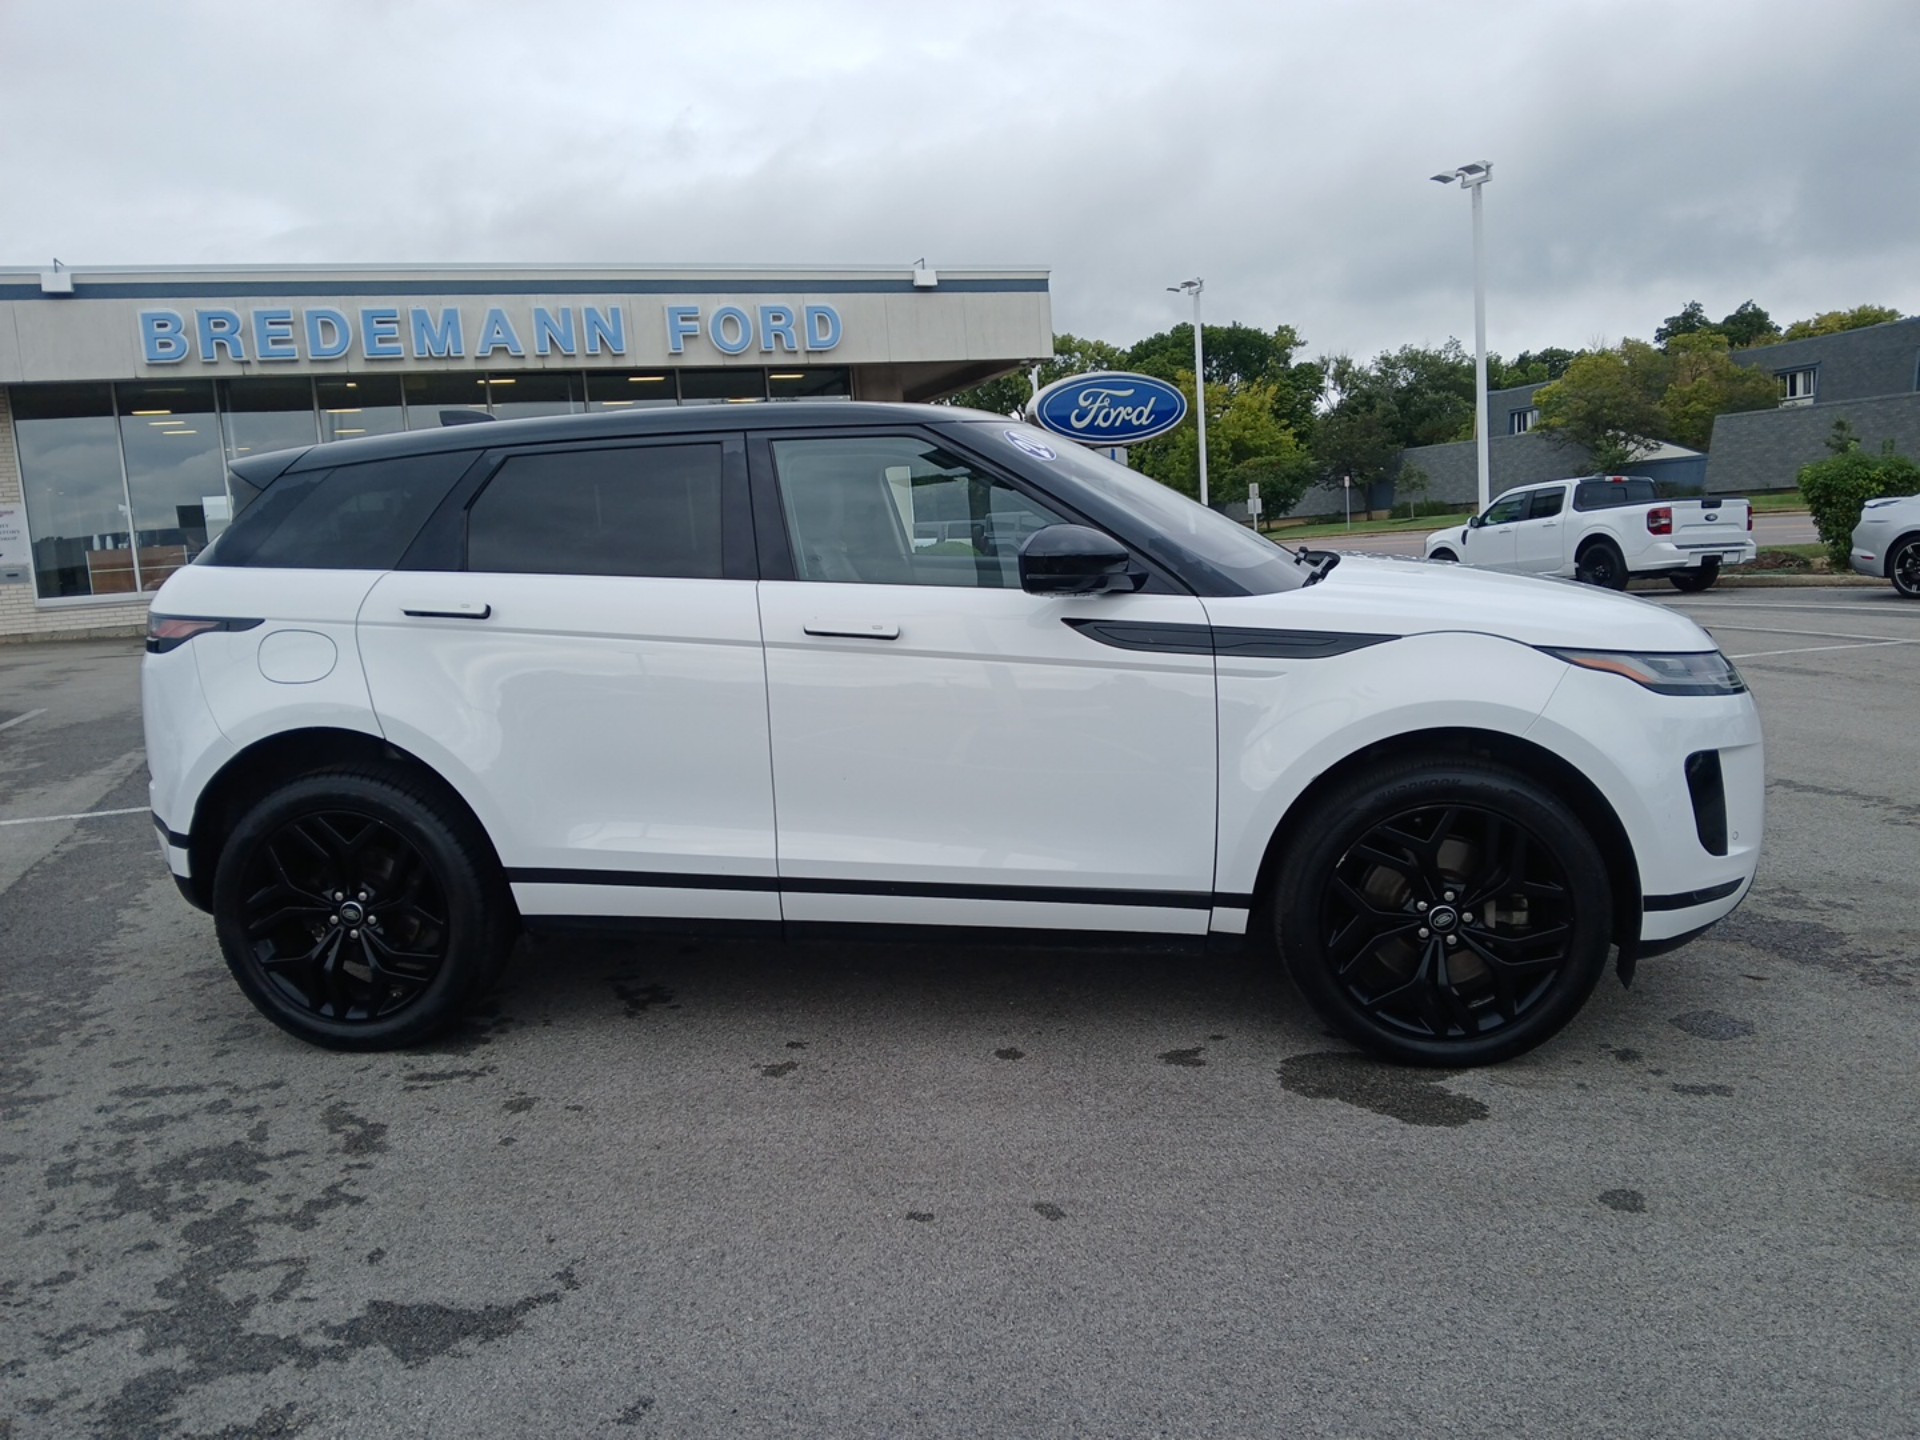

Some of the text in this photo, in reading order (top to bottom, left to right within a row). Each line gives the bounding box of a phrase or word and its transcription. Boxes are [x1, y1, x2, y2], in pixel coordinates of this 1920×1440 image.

[137, 302, 845, 366] BREDEMANN FORD
[1070, 388, 1157, 430] Ford
